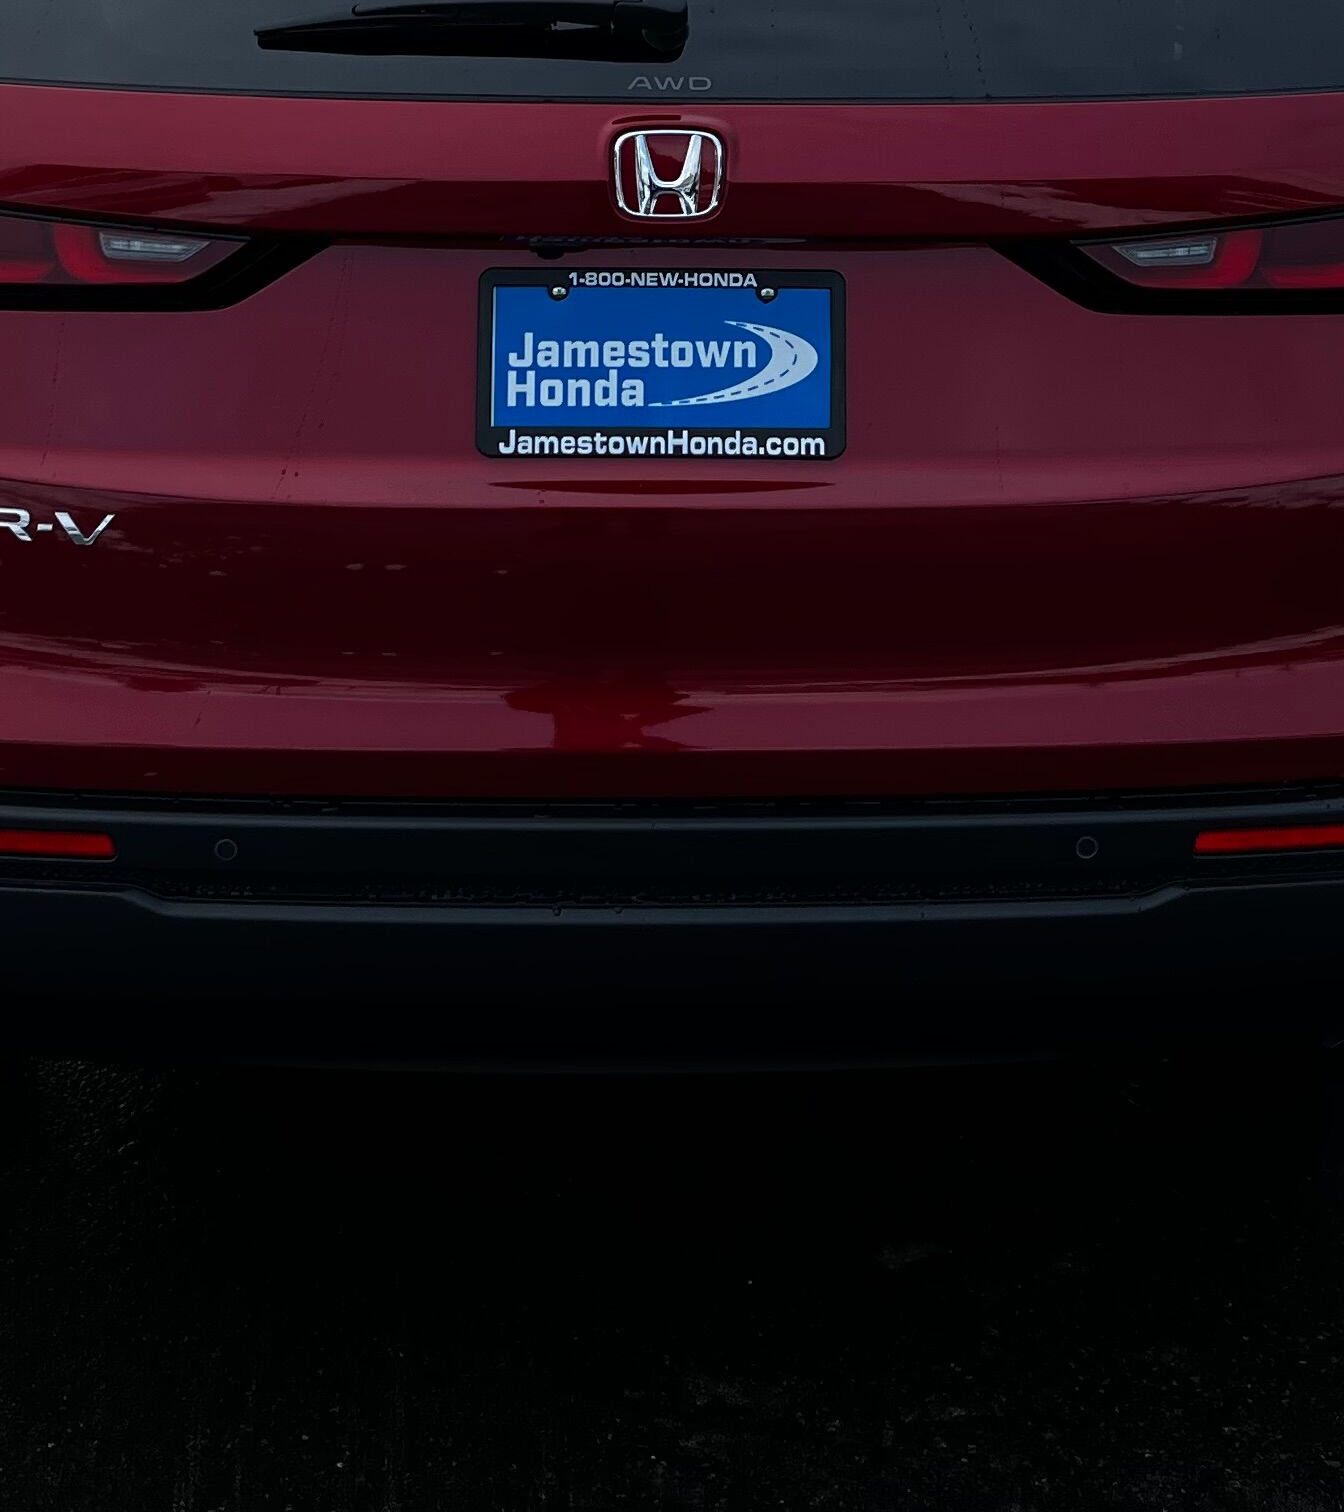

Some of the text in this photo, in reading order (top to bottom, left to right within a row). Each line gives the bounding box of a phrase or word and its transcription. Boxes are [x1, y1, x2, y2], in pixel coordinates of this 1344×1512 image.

[627, 76, 712, 91] AWD
[568, 272, 757, 288] 1-800-NEW-HONDA
[508, 332, 757, 369] Jamestown
[506, 369, 645, 407] Honda
[498, 429, 826, 456] JamestownHonda.com
